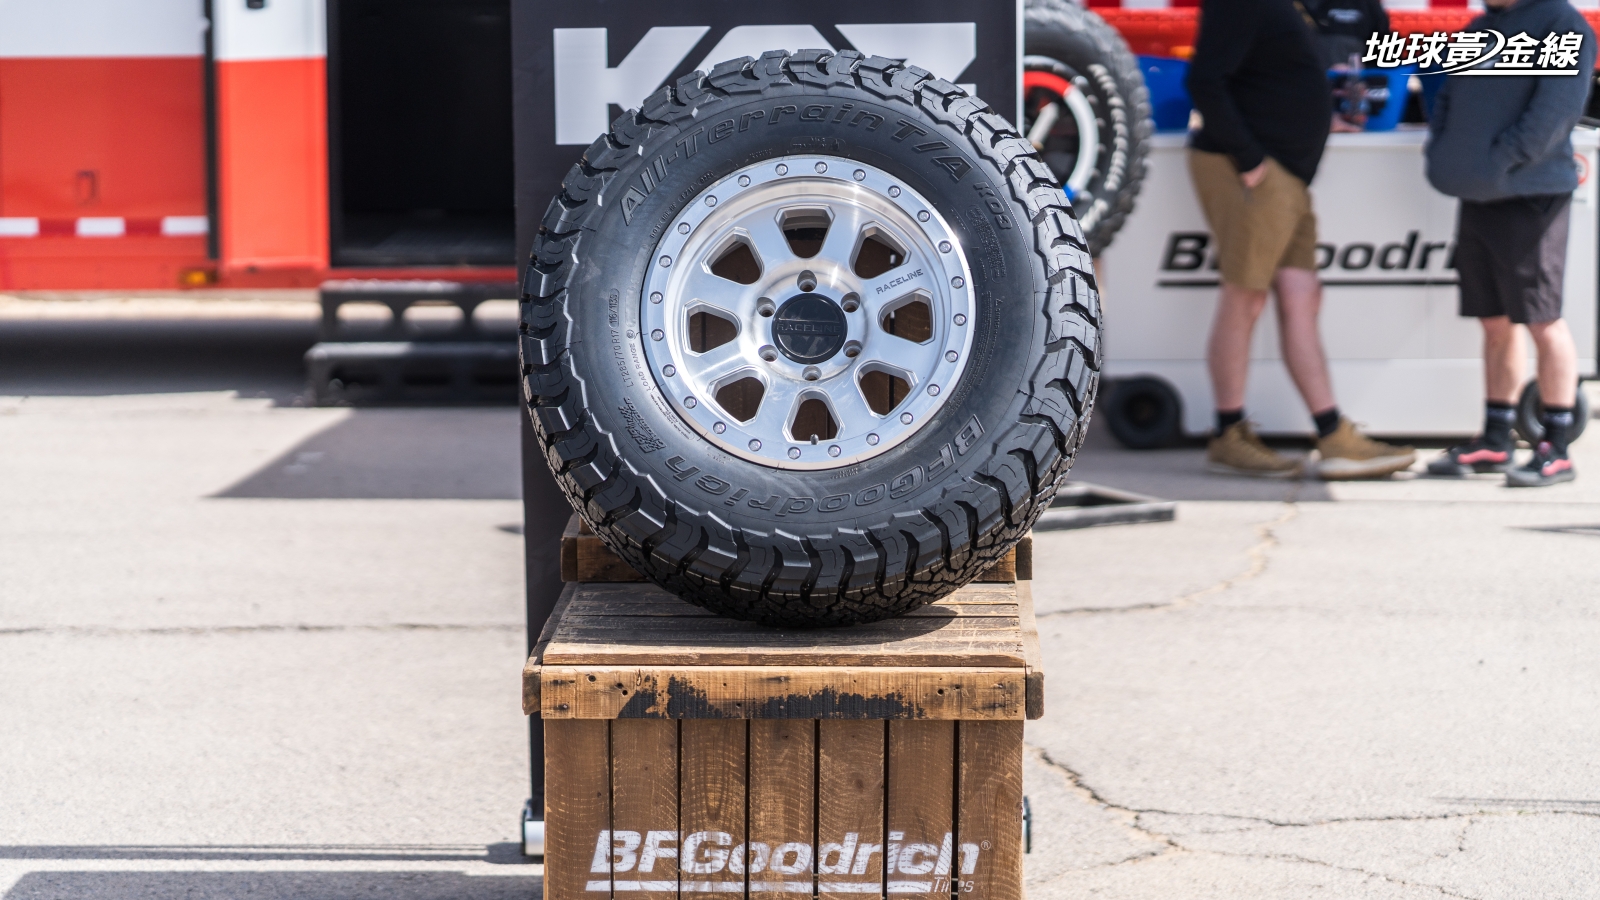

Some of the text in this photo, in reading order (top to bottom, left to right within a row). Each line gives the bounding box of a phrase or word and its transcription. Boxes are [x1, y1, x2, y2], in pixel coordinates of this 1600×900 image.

[620, 102, 1013, 229] All-Terrain T/A KO3
[875, 268, 924, 295] RACELINE
[776, 322, 842, 333] RACELINE
[629, 343, 642, 370] RANGE
[638, 371, 652, 392] LOAD
[664, 414, 985, 517] BFGoodrich
